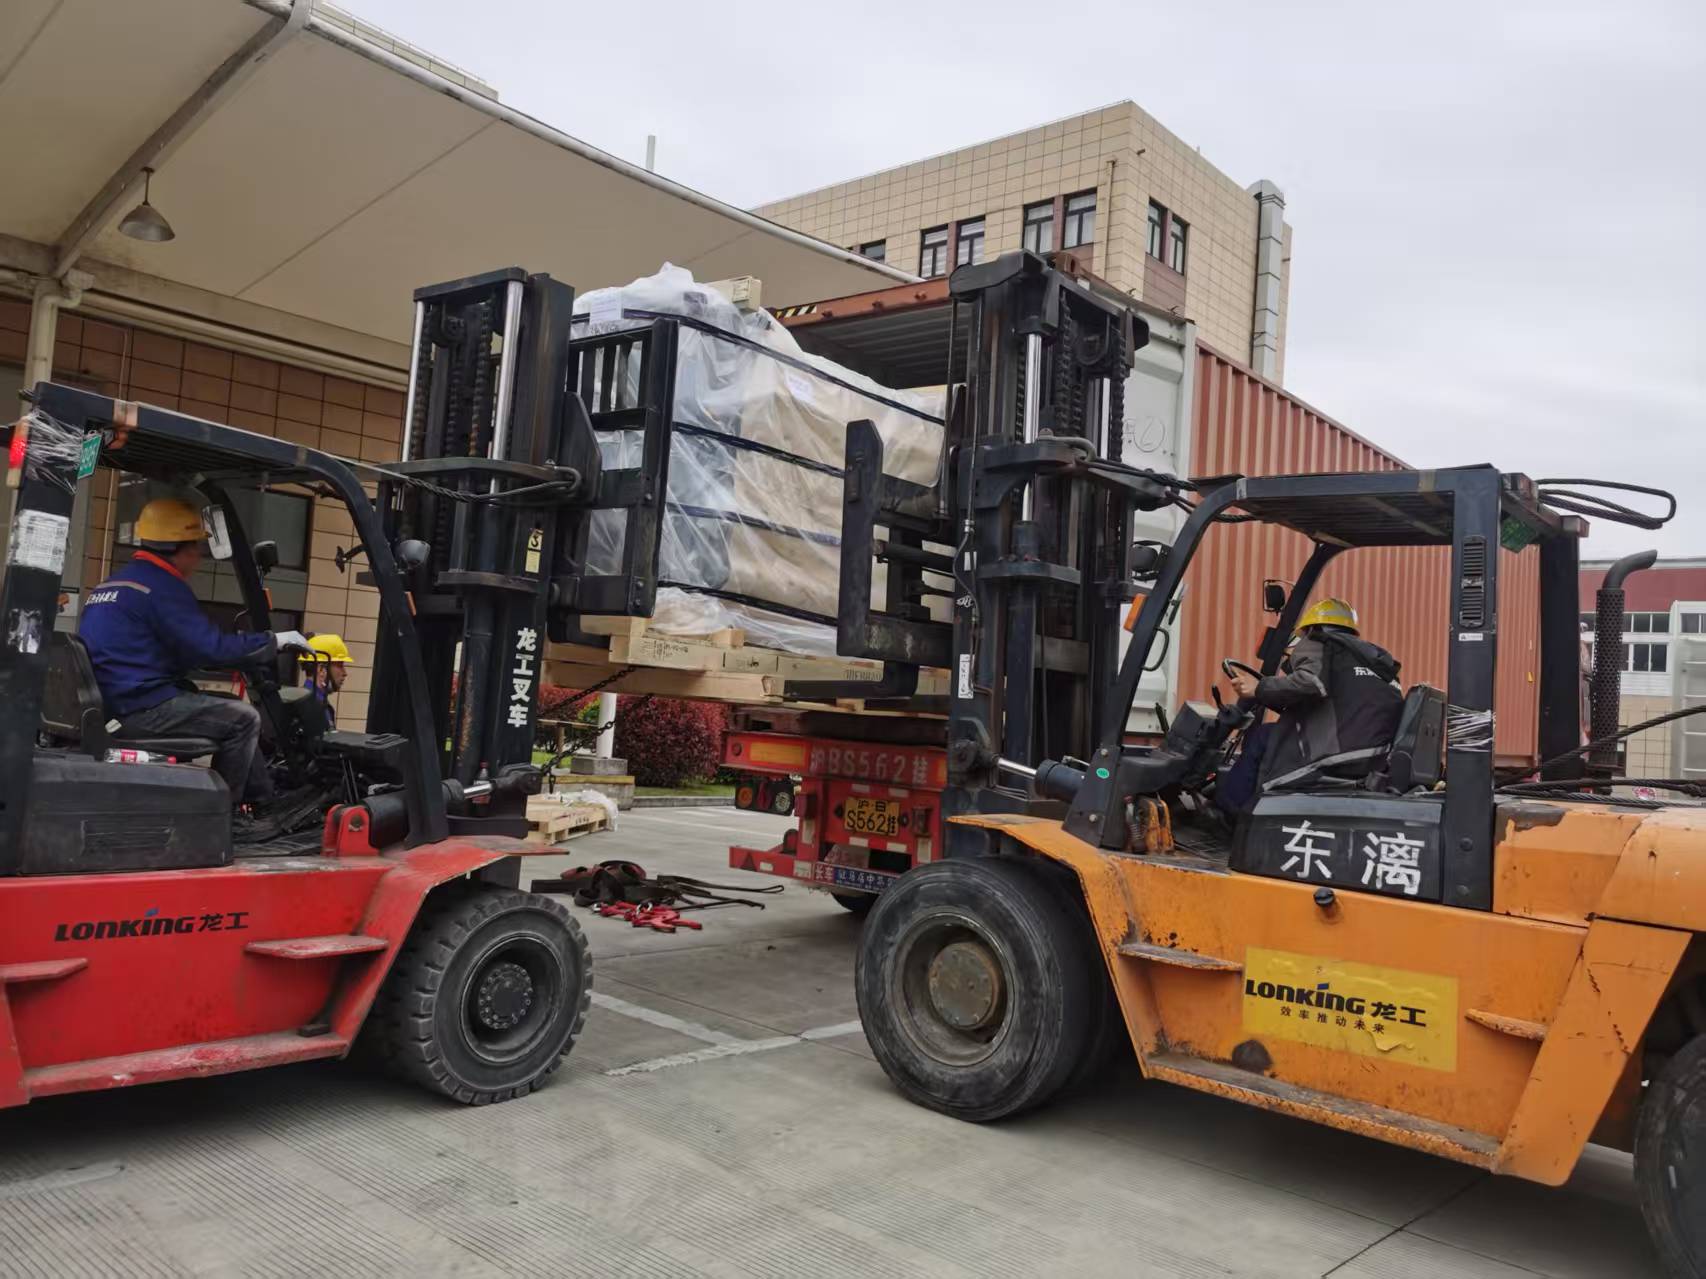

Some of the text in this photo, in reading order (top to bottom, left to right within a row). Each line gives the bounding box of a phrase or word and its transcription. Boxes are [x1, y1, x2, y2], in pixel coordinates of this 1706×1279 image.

[507, 627, 537, 728] 龙工叉车
[54, 907, 249, 941] LONKING 龙工
[1245, 979, 1427, 1027] LONKING 龙工
[1280, 1005, 1385, 1034] 效率推动未来
